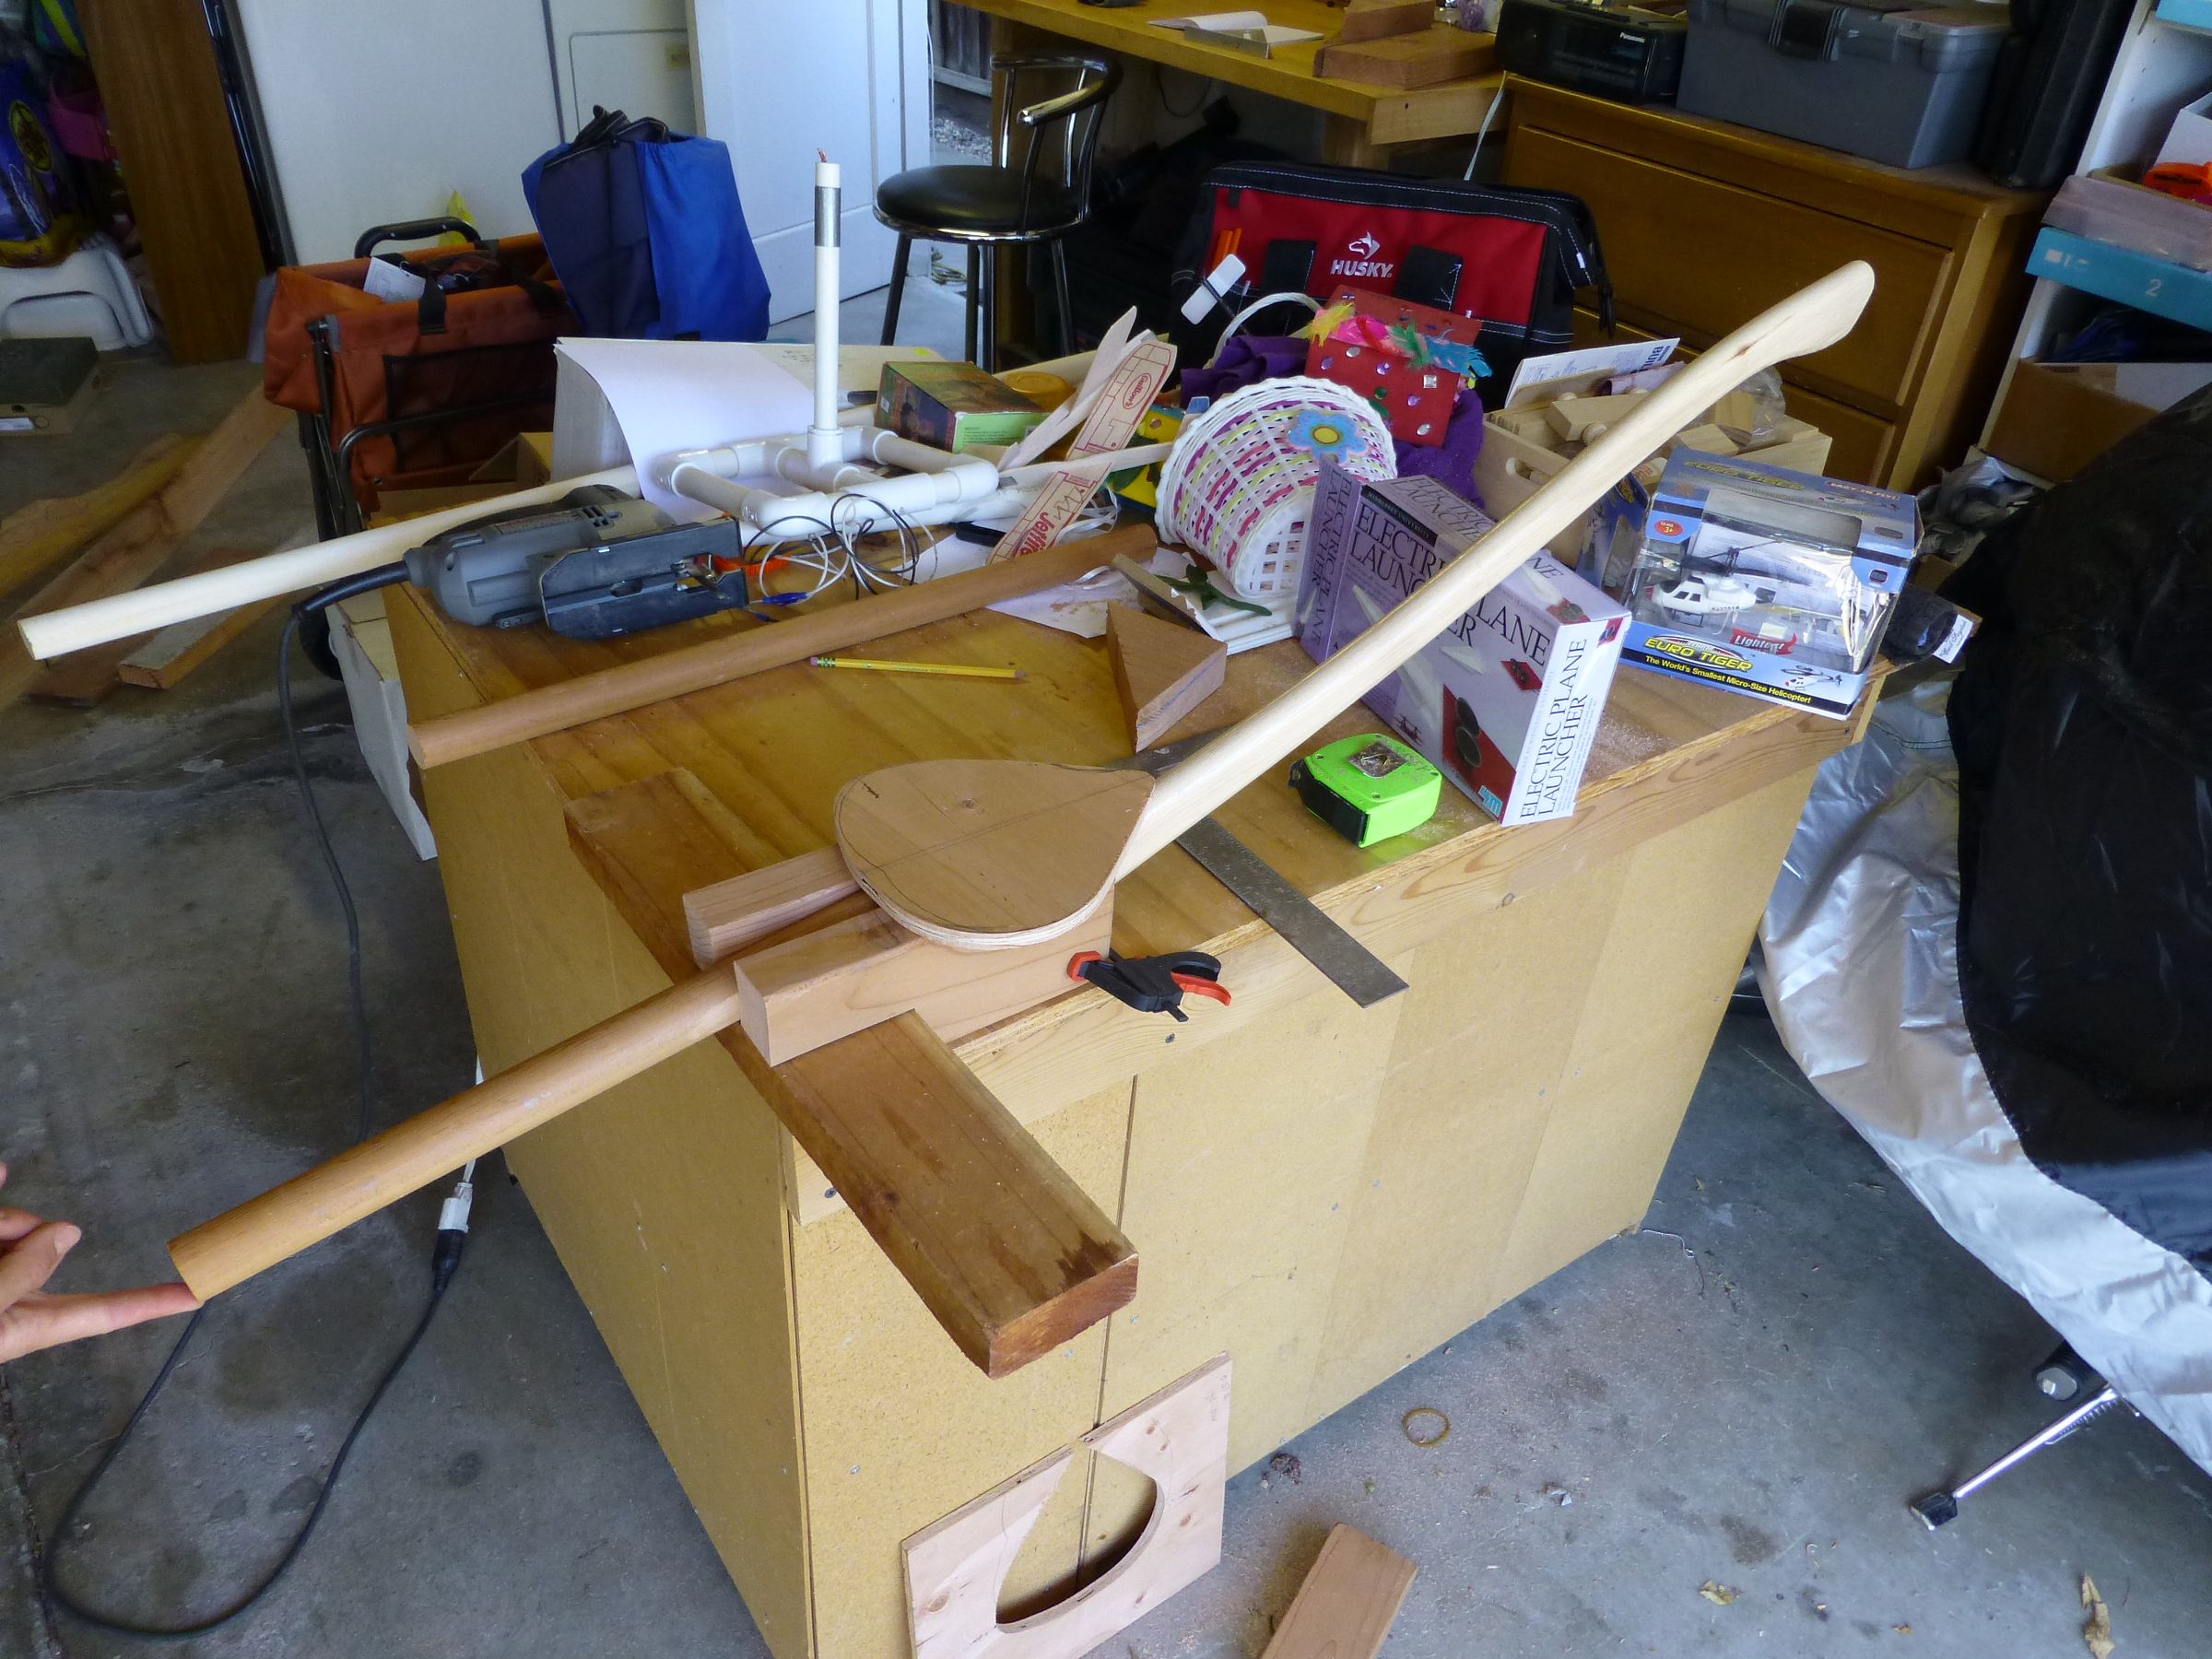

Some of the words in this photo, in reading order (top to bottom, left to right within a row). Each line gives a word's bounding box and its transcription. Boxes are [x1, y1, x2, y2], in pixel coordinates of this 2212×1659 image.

[1330, 259, 1394, 277] HUSKY
[2146, 278, 2162, 296] 2
[1312, 469, 1342, 586] LAUNCHER
[1324, 476, 1352, 575] ELECTRIC
[1476, 593, 1550, 667] LANE
[1644, 637, 1695, 658] EURO
[1699, 651, 1753, 673] TIGER
[1645, 655, 1660, 665] The
[1662, 660, 1690, 673] World's
[1692, 667, 1725, 682] Smallest
[1726, 676, 1768, 693] Micro-Size
[1769, 687, 1812, 704] Helicopter!
[1520, 720, 1562, 818] ELECTRIC
[1550, 639, 1587, 715] PLANE
[1538, 694, 1588, 817] LAUNCHER
